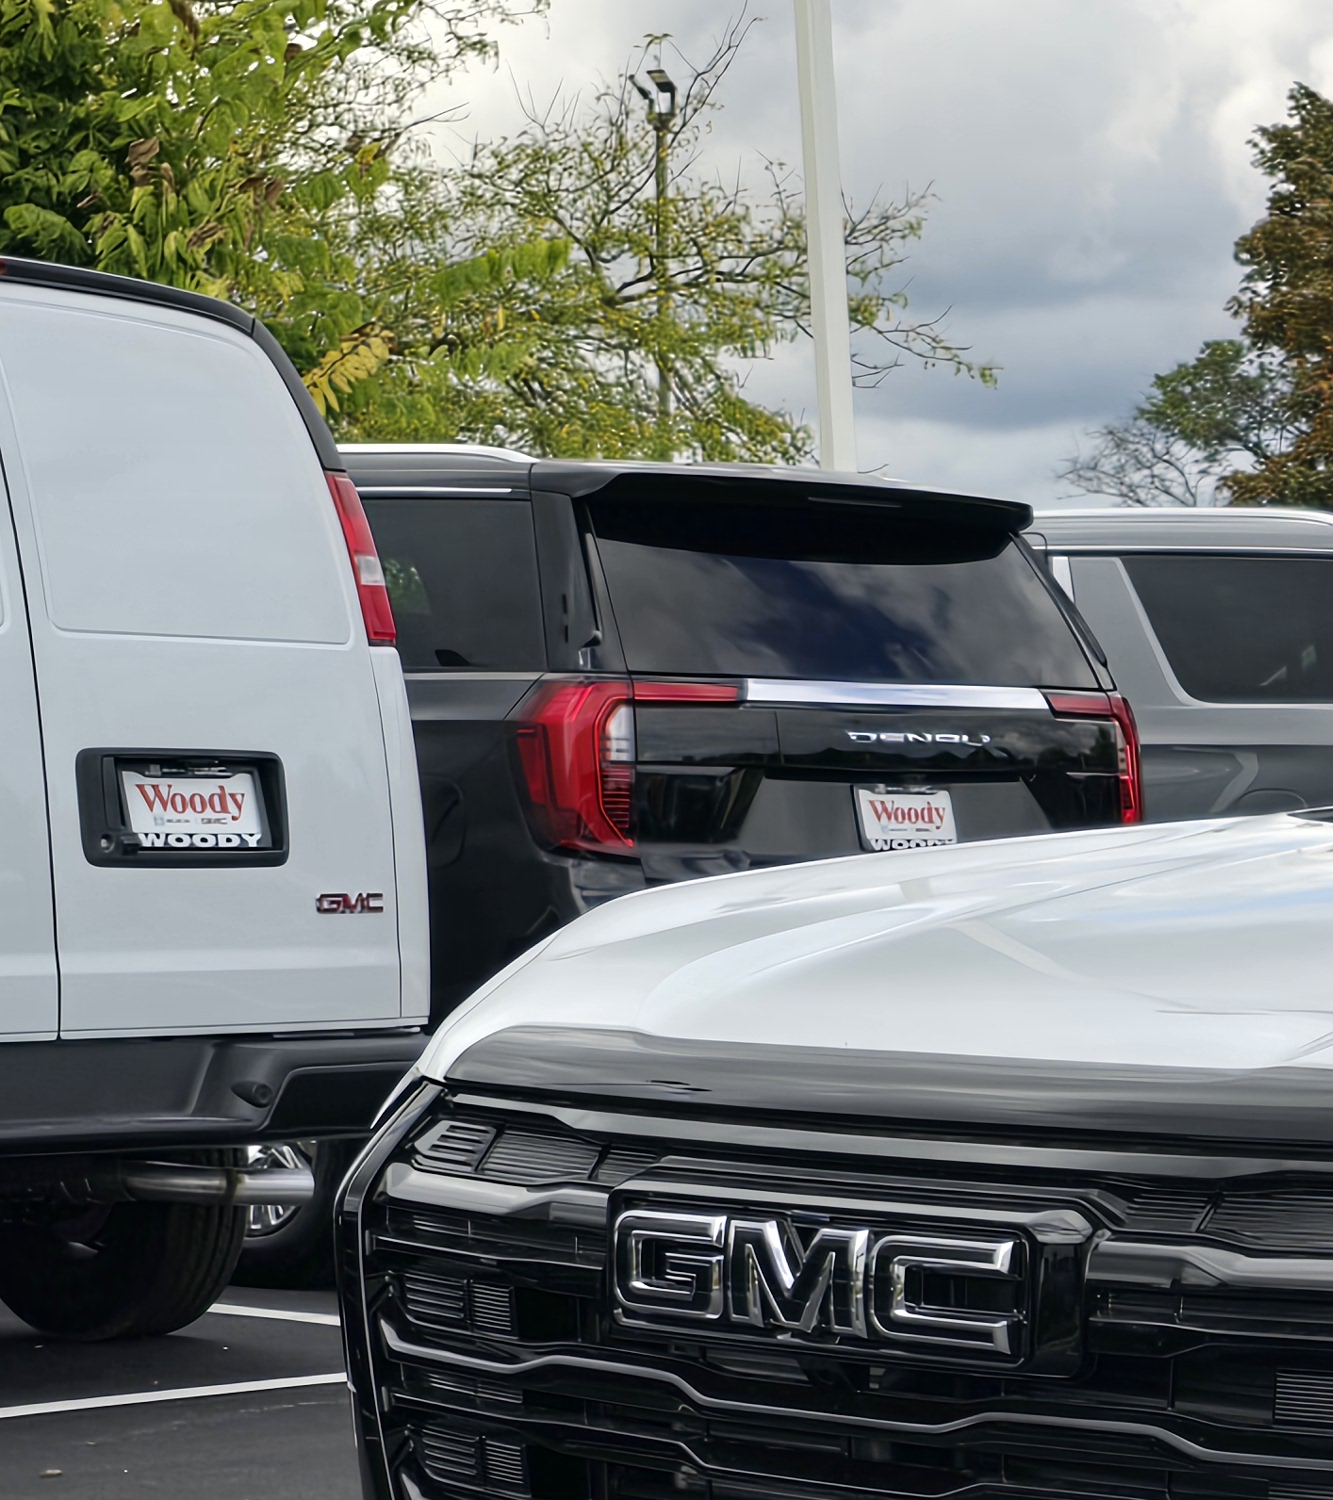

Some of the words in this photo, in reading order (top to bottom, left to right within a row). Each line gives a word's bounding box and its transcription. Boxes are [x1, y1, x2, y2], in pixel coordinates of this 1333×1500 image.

[845, 731, 991, 747] DENALI
[135, 783, 245, 822] Woody
[868, 800, 946, 830] Woody
[138, 832, 262, 848] WOODY
[315, 893, 384, 914] GMC
[612, 1209, 1020, 1356] GMC
